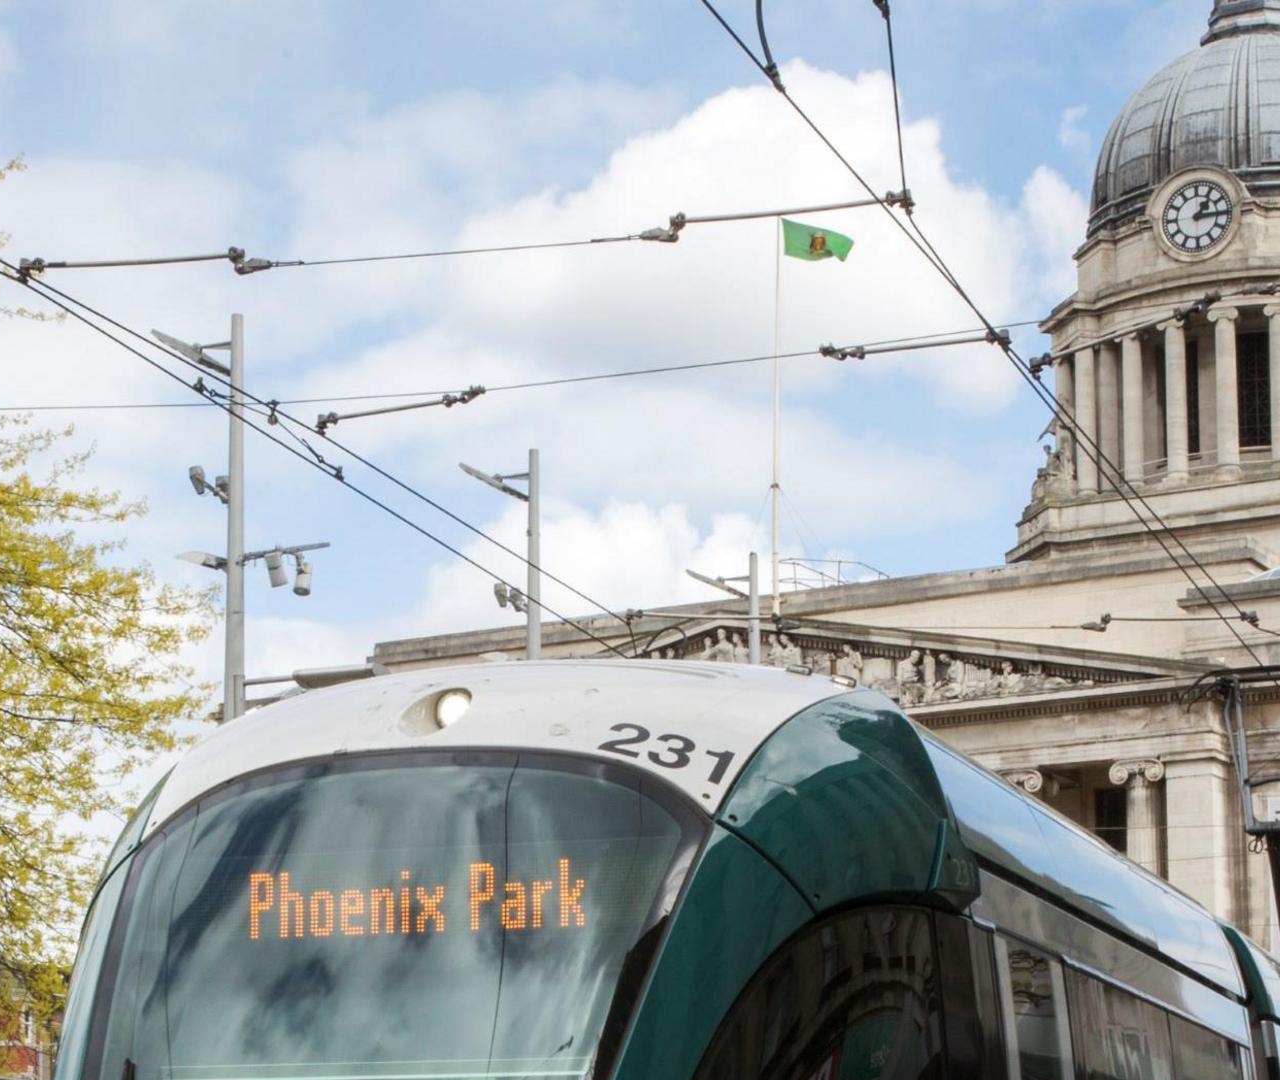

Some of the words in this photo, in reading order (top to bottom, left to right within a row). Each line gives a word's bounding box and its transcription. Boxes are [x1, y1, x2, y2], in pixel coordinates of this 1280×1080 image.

[596, 722, 736, 785] 231
[250, 870, 445, 939] Phoenix
[469, 858, 585, 931] Park
